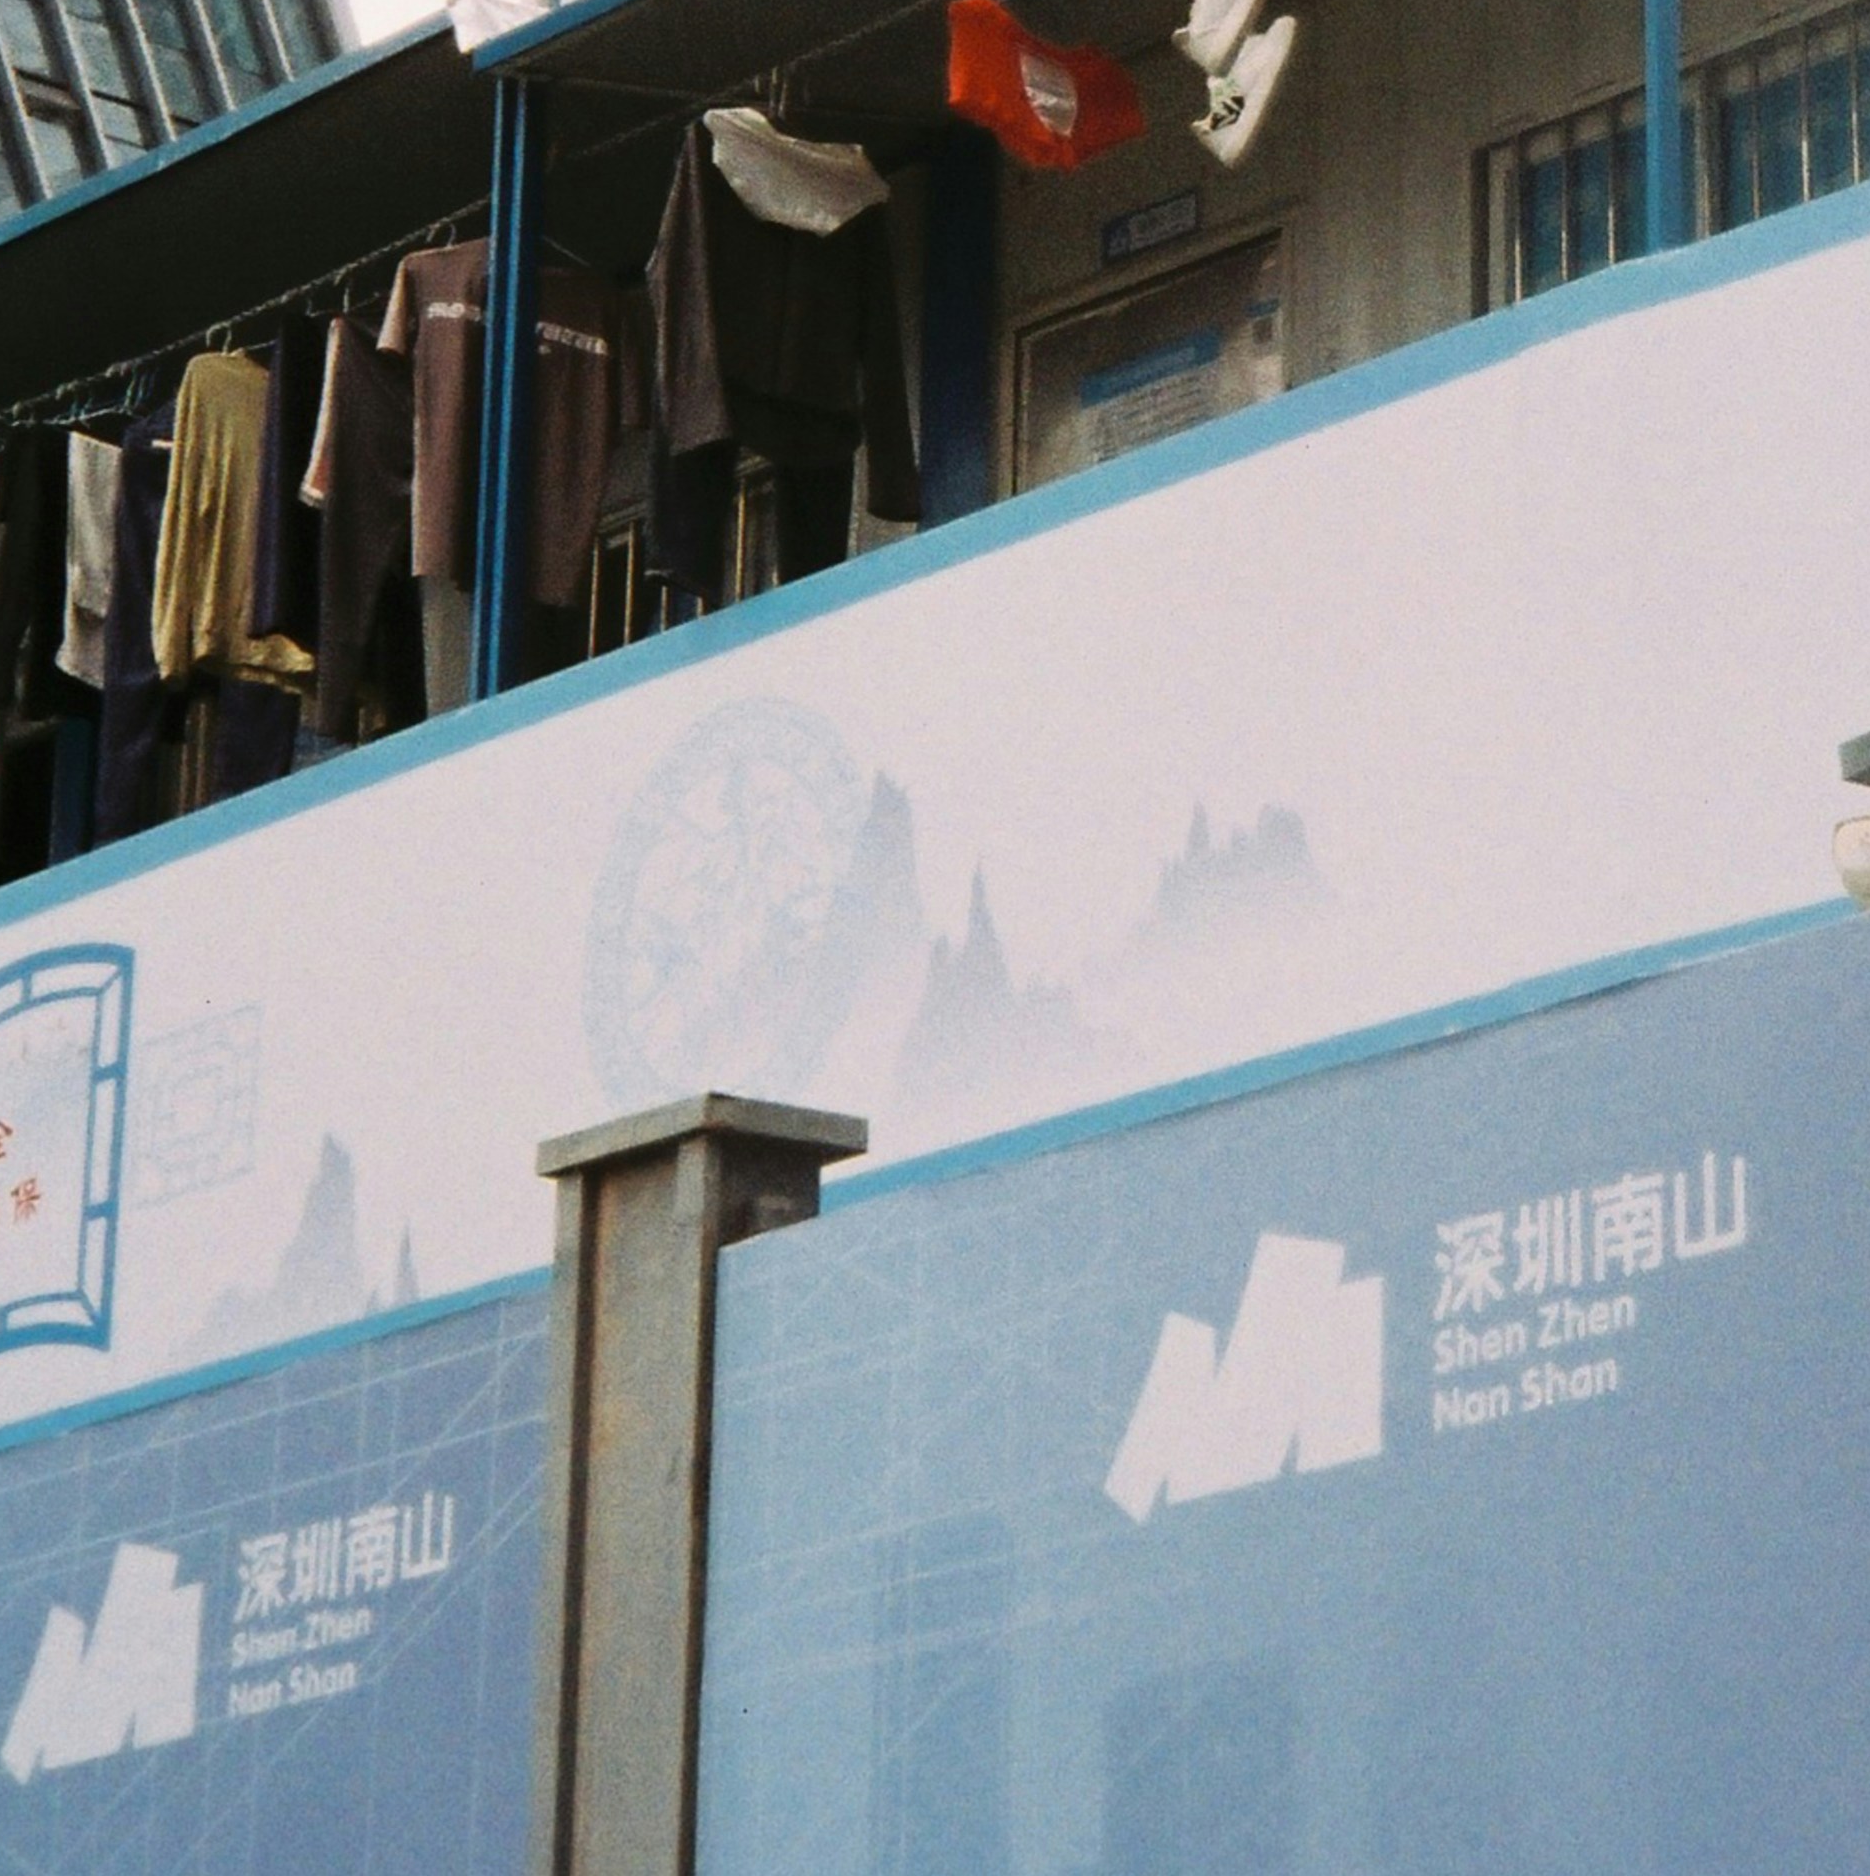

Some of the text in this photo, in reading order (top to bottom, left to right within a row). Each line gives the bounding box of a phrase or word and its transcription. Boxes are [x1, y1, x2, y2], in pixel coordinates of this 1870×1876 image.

[1433, 1150, 1746, 1321] 深圳南山
[1433, 1295, 1636, 1375] Shen Zhen
[1433, 1358, 1618, 1431] Nan Shan
[233, 1490, 454, 1622] 深圳南山
